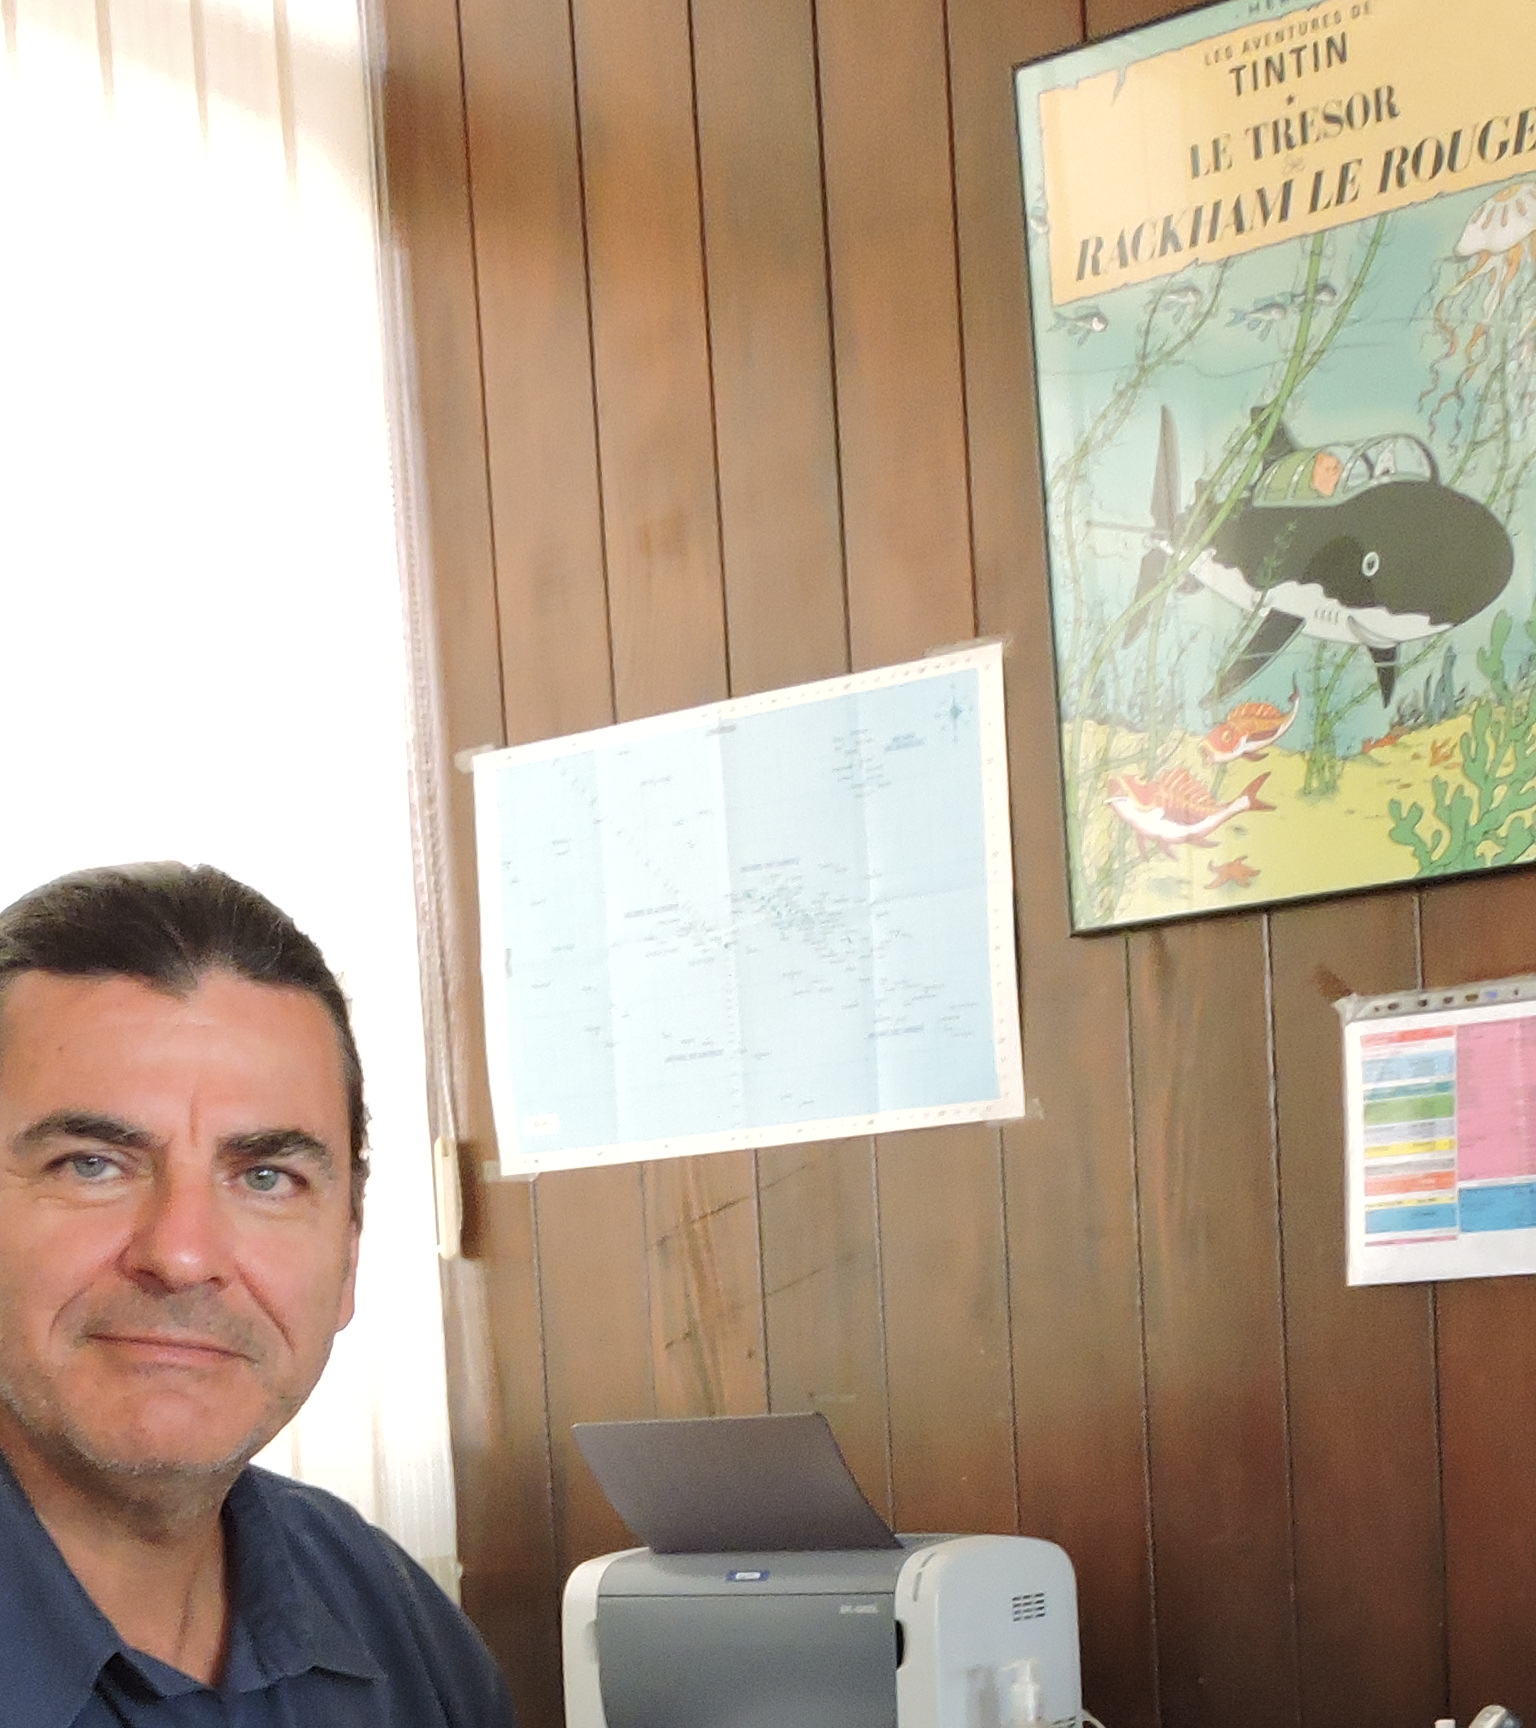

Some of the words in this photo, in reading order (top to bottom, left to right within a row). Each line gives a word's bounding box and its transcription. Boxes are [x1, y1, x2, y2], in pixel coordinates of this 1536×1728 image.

[1229, 31, 1348, 97] TINTIN
[1189, 134, 1233, 180] LE
[1075, 179, 1292, 283] RACKHAM
[1307, 157, 1361, 215] LE
